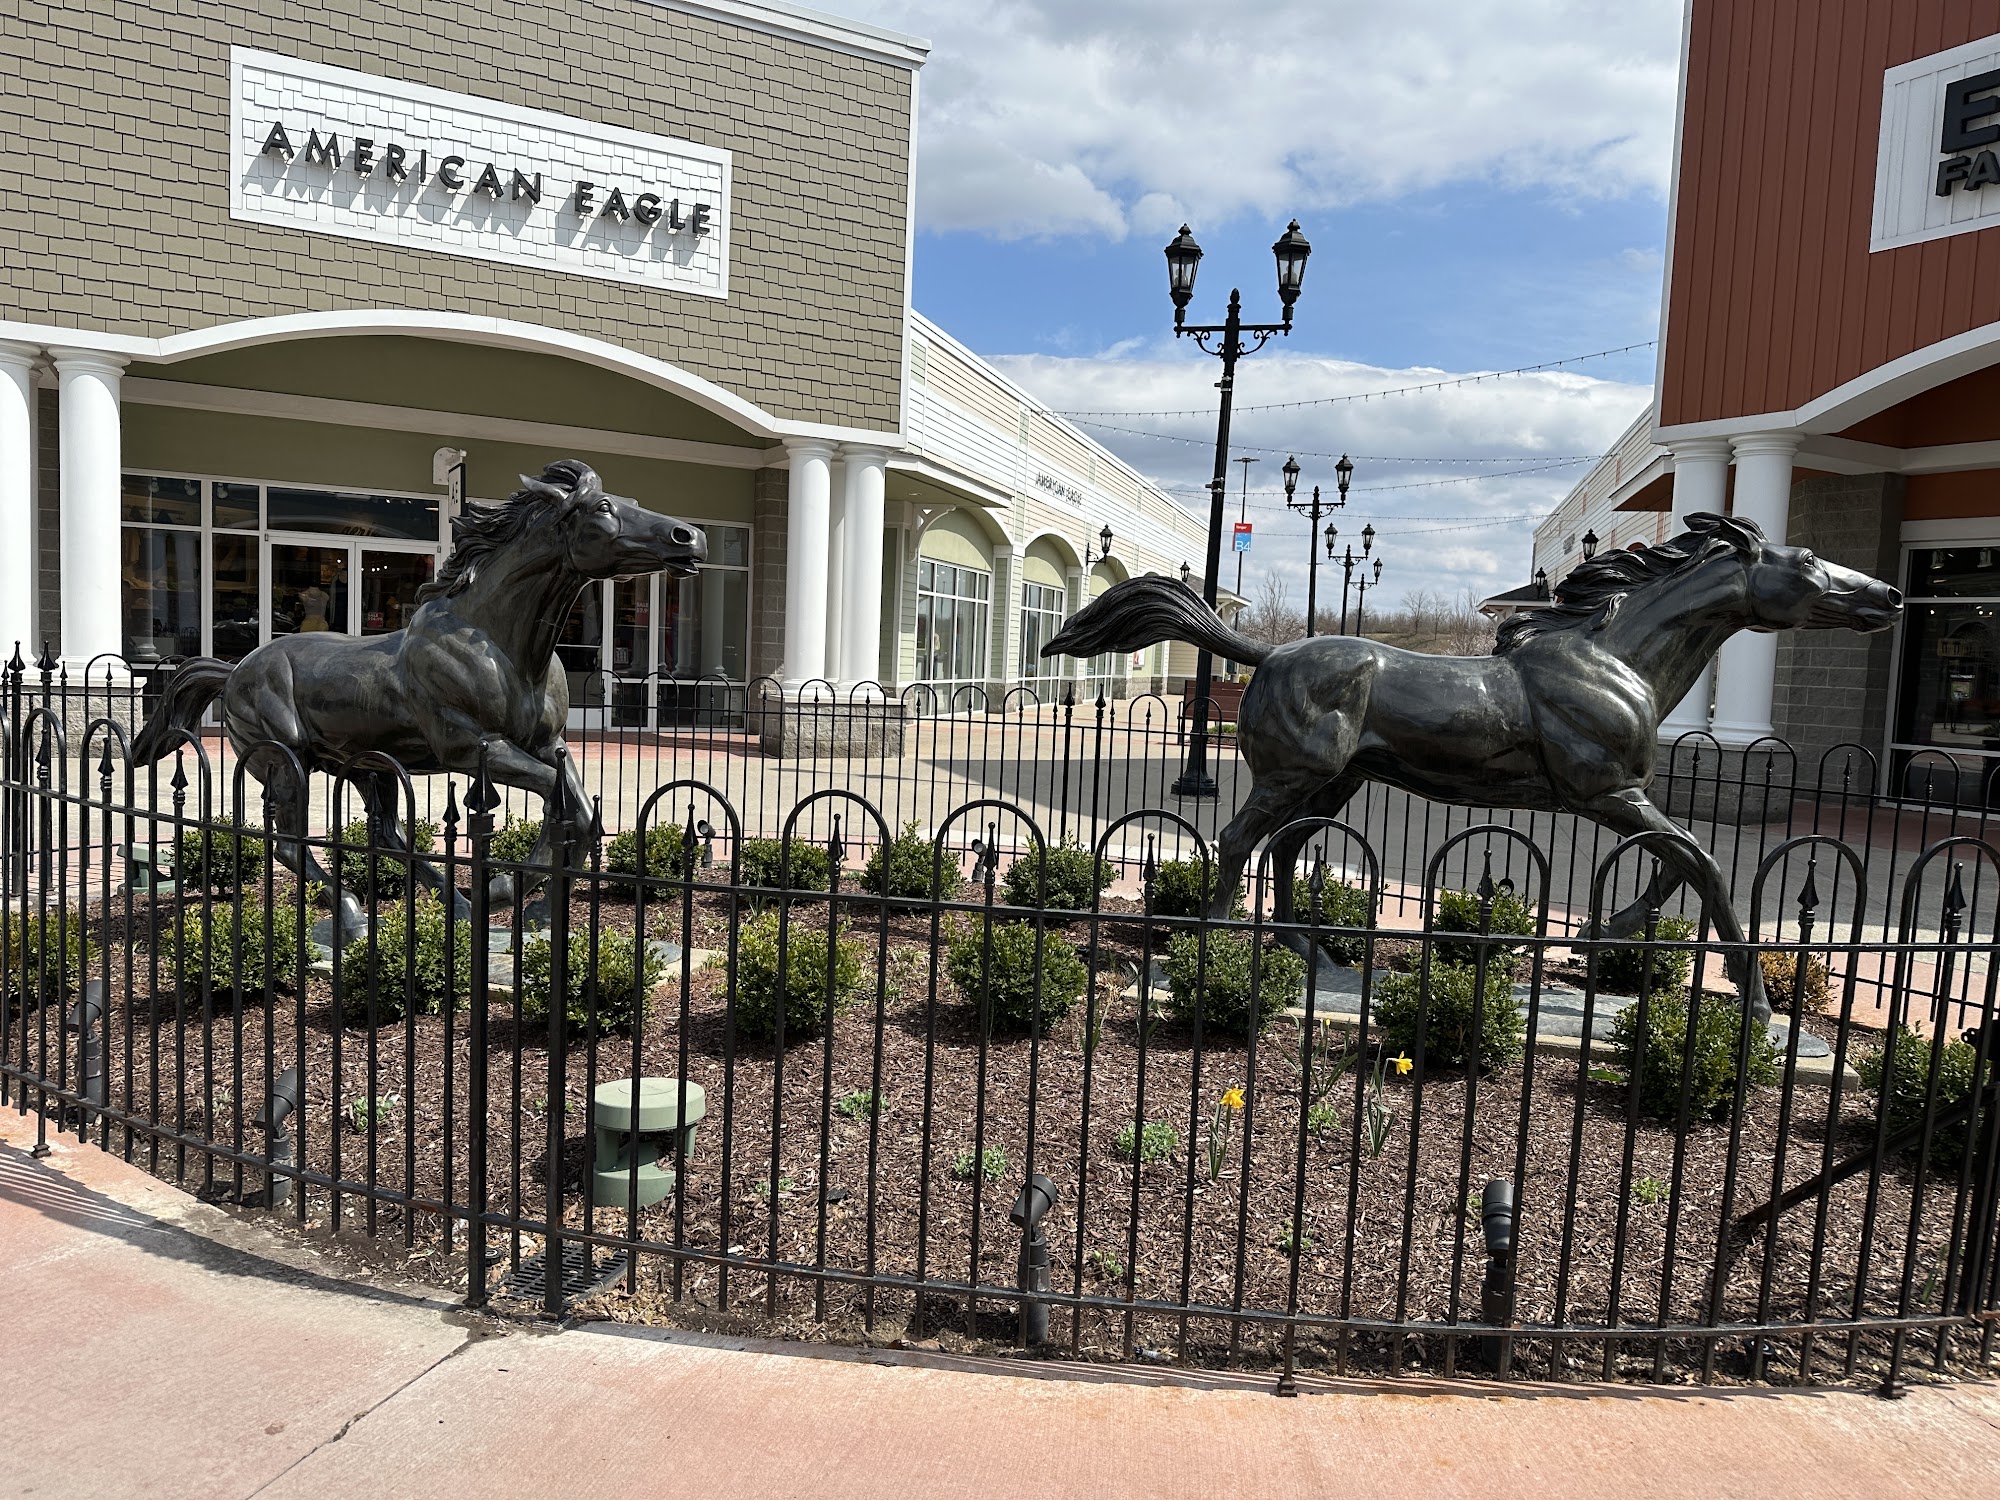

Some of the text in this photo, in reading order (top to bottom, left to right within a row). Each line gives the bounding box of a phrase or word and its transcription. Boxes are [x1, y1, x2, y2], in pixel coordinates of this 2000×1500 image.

[262, 121, 711, 235] AMERICAN EAGLE
[1235, 541, 1250, 552] B4
